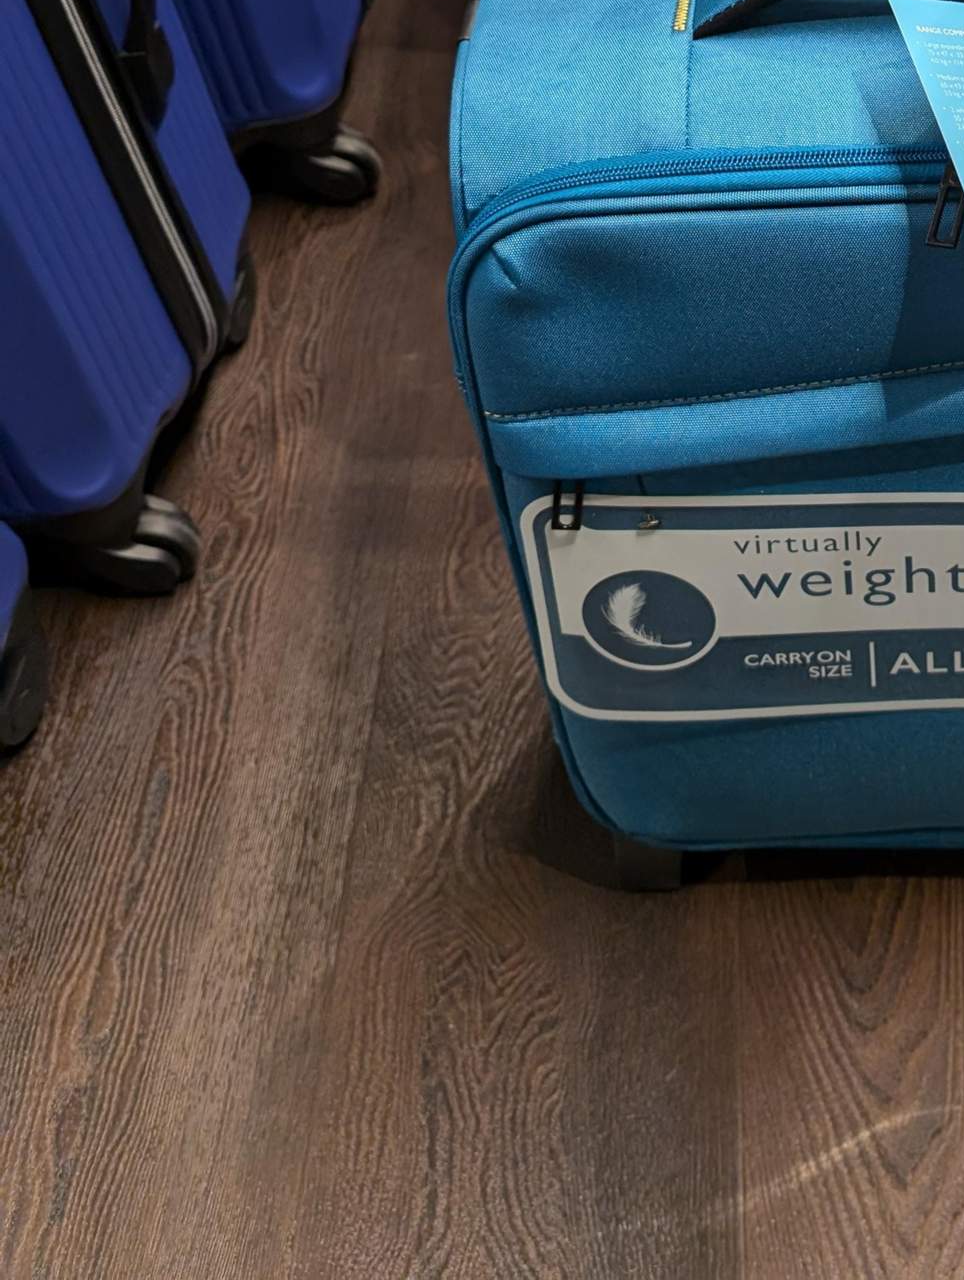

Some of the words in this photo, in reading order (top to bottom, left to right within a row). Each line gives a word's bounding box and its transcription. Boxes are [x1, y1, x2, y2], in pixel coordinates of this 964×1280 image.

[734, 531, 882, 556] virtually
[744, 651, 815, 666] CARRY
[817, 650, 851, 663] ON
[809, 664, 852, 678] SIZE
